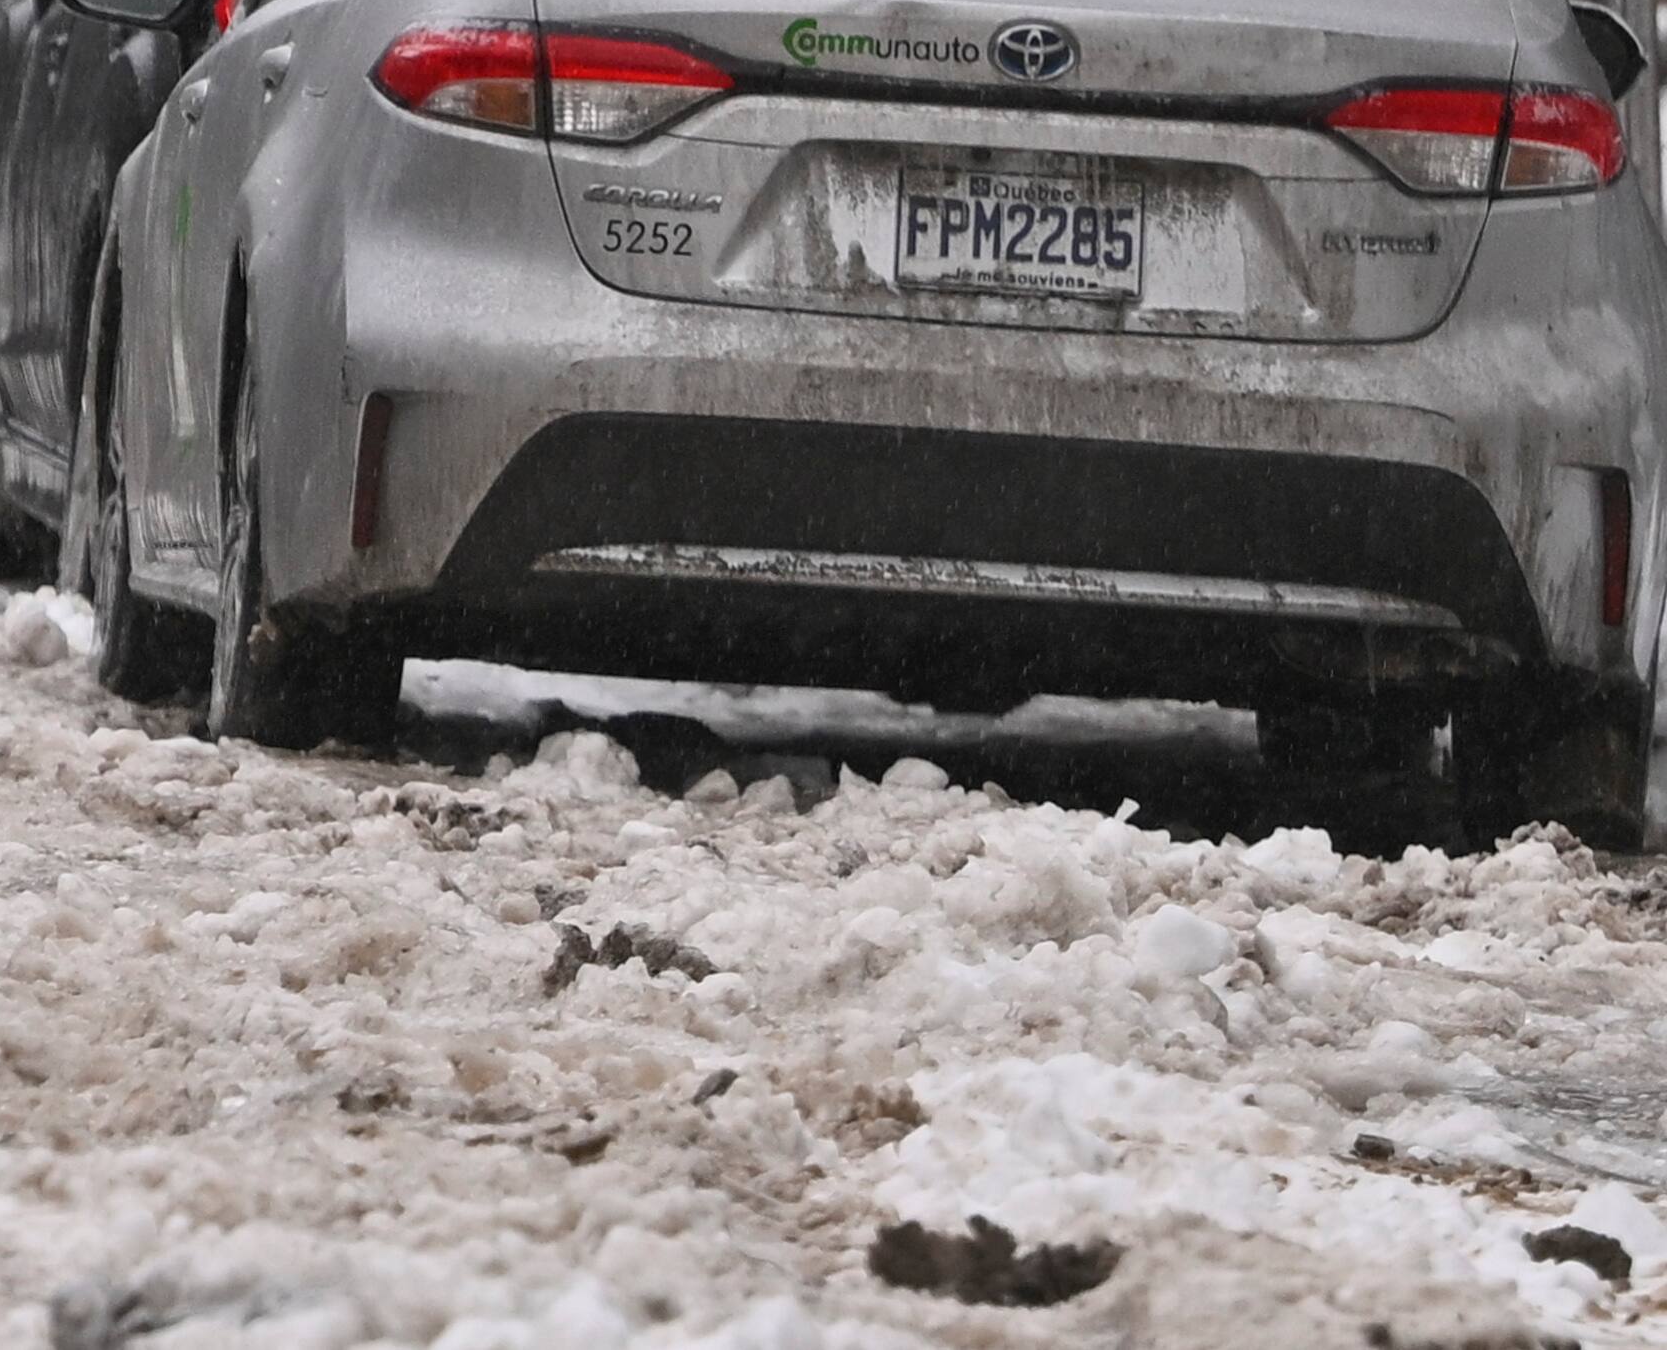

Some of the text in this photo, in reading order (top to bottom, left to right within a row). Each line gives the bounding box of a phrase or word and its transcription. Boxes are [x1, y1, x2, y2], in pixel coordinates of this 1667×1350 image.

[782, 17, 979, 66] Communauto
[603, 219, 692, 256] 5252
[907, 195, 1134, 270] FPM2285
[1008, 271, 1085, 288] souviens
